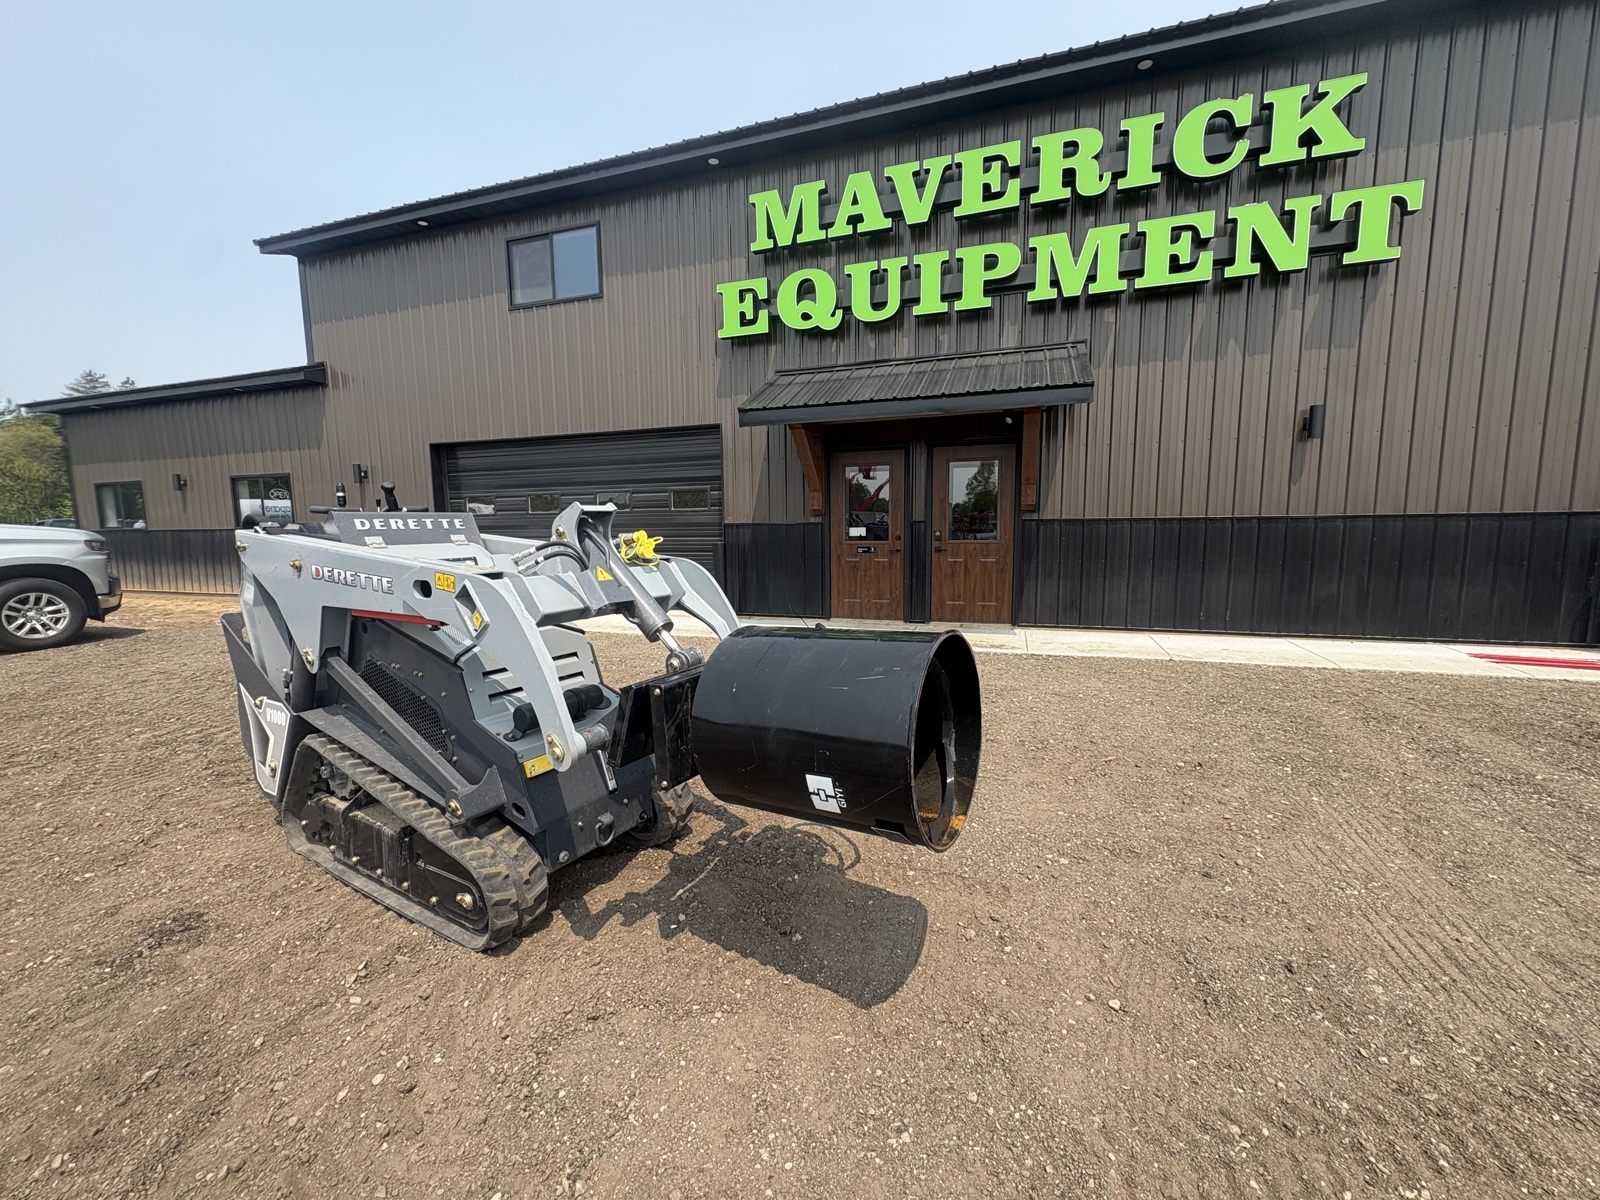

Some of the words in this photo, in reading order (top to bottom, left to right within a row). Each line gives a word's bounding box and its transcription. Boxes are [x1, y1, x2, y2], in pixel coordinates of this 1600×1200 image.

[749, 72, 1368, 252] MAVERICK
[716, 178, 1425, 339] EQUIPMENT
[269, 490, 289, 499] OPEN
[353, 518, 466, 531] DERETTE
[311, 564, 394, 595] DERETTE
[266, 707, 286, 727] V1000
[834, 788, 847, 808] GIYI
